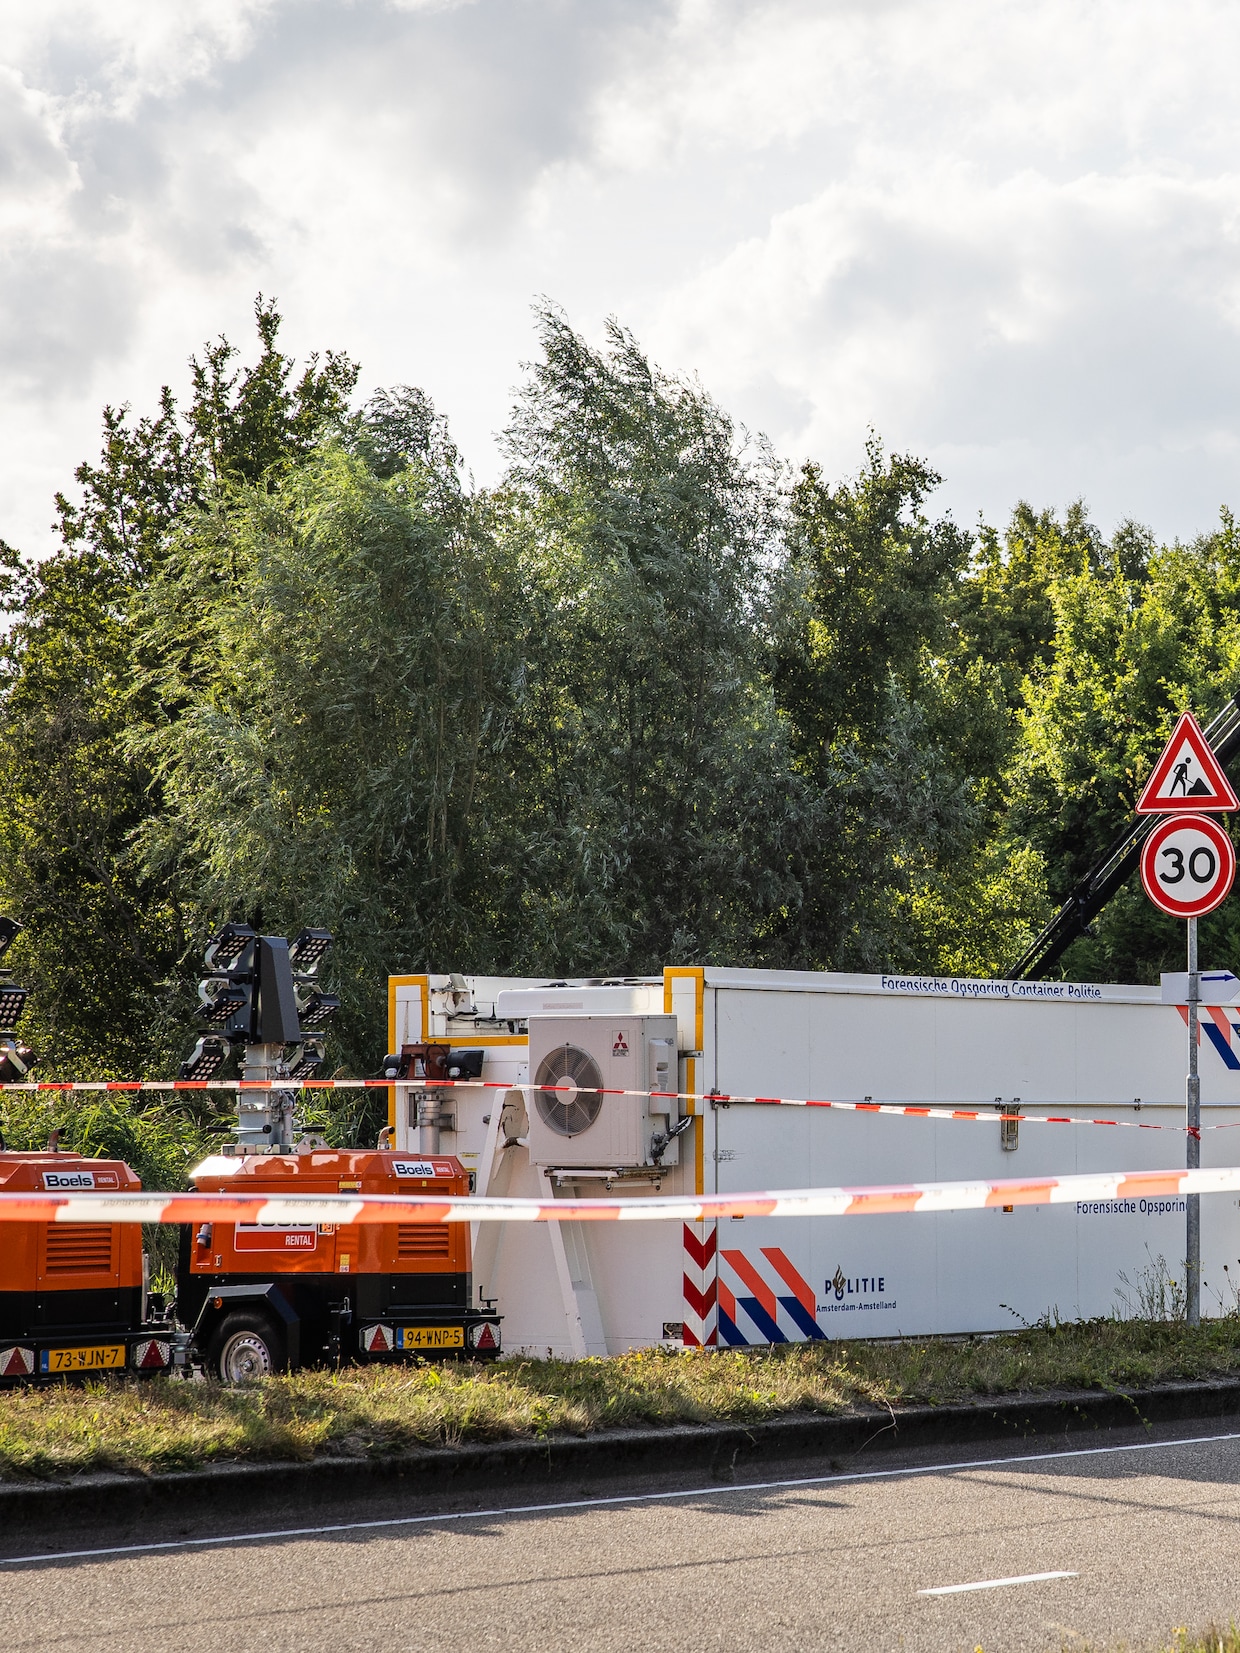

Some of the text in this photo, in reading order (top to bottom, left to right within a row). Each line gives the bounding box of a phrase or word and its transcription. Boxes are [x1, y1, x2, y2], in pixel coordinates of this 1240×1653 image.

[1159, 846, 1216, 884] 30
[881, 976, 1102, 998] Forensische Opsporing Container Politie
[394, 1164, 433, 1175] Boels
[45, 1174, 93, 1187] Boels
[1076, 1199, 1136, 1214] Forensische
[285, 1235, 312, 1246] RENTAL
[825, 1277, 885, 1301] POLITIE
[816, 1300, 897, 1313] Amsterdam-Amstelland
[406, 1330, 460, 1346] 94-WNP-5
[55, 1348, 119, 1369] 73-WJN-7
